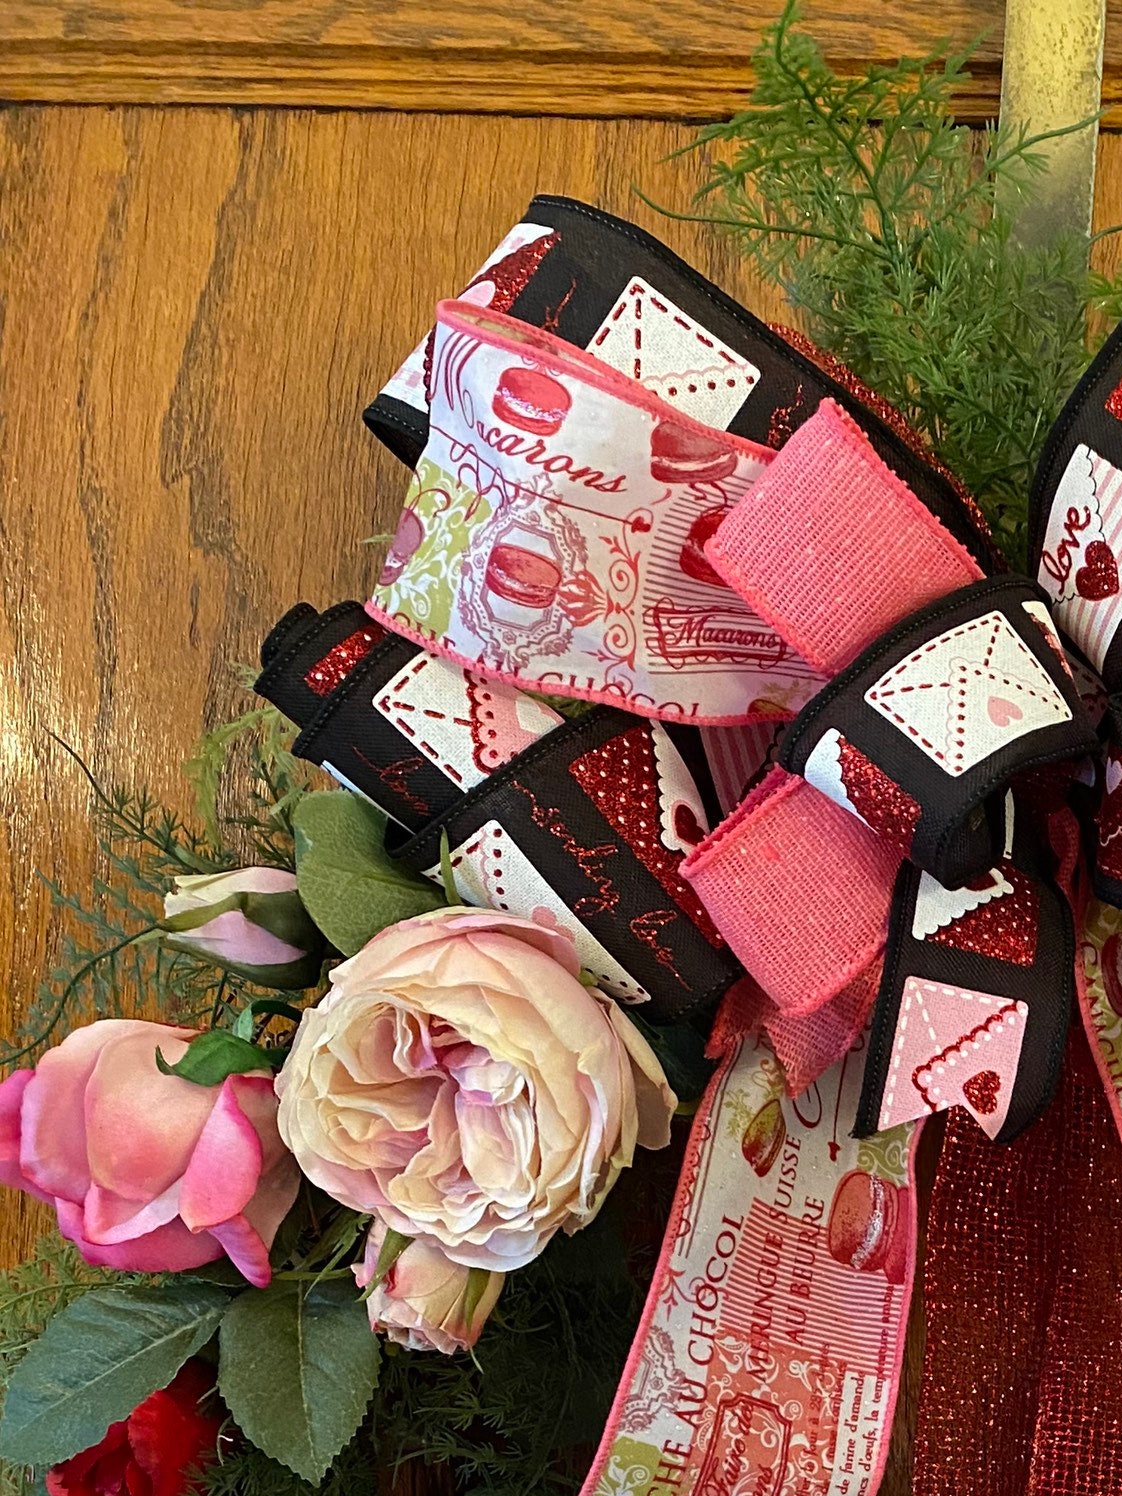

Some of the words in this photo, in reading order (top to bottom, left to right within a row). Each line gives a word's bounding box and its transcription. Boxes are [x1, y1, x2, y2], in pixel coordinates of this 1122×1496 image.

[1042, 505, 1092, 597] love
[661, 612, 782, 652] Macarons
[747, 1232, 783, 1382] MERINGUE
[766, 1135, 802, 1223] SUISSE
[790, 1196, 825, 1296] BEURRE
[690, 1216, 744, 1364] CHOCOL
[785, 1305, 806, 1346] AU
[864, 1409, 879, 1420] la
[878, 1283, 895, 1324] ambia
[675, 1377, 708, 1429] AU
[836, 1477, 850, 1494] de
[840, 1438, 856, 1473] farine
